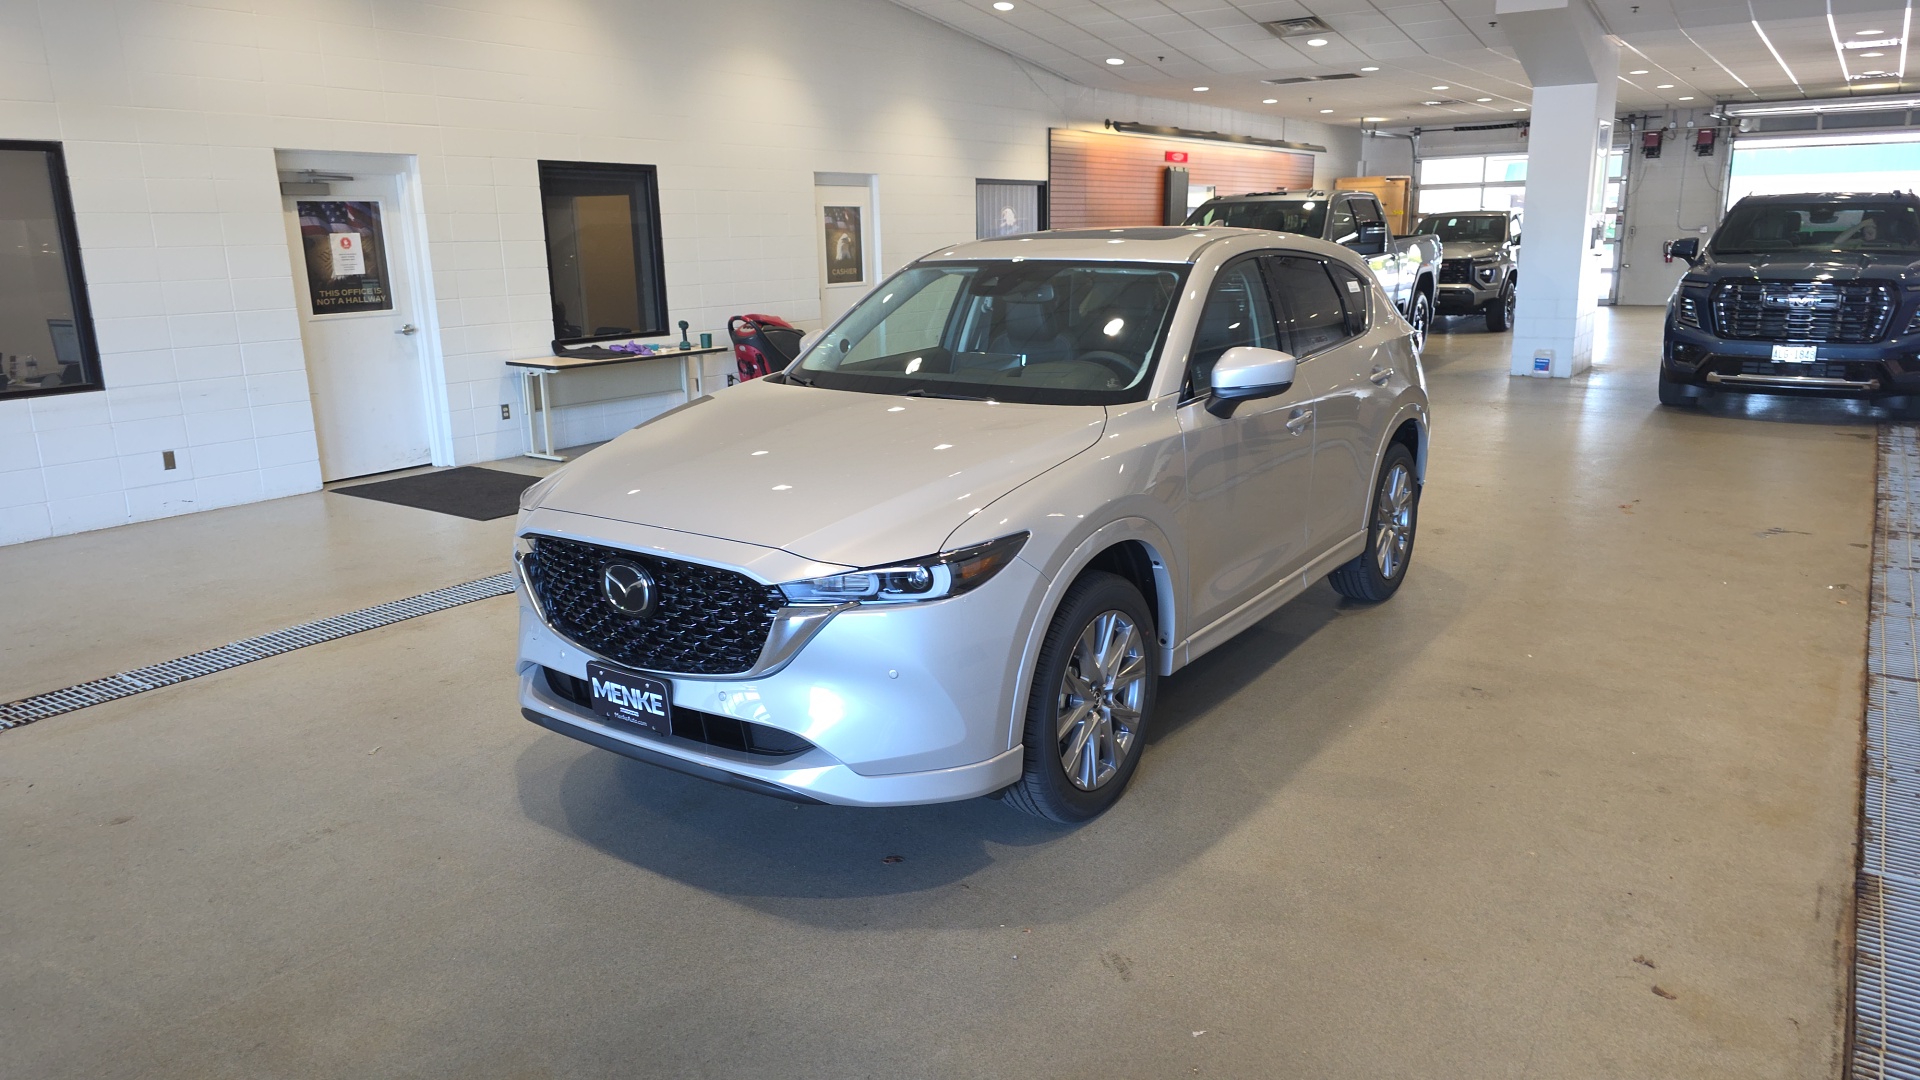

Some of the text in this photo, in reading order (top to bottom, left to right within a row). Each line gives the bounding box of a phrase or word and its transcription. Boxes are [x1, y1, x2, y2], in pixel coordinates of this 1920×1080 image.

[832, 267, 858, 276] CASHIER
[319, 287, 382, 297] THIS OFFICE IS
[316, 297, 336, 306] NOT
[346, 294, 387, 304] HALLWAY
[591, 676, 665, 716] MENKE
